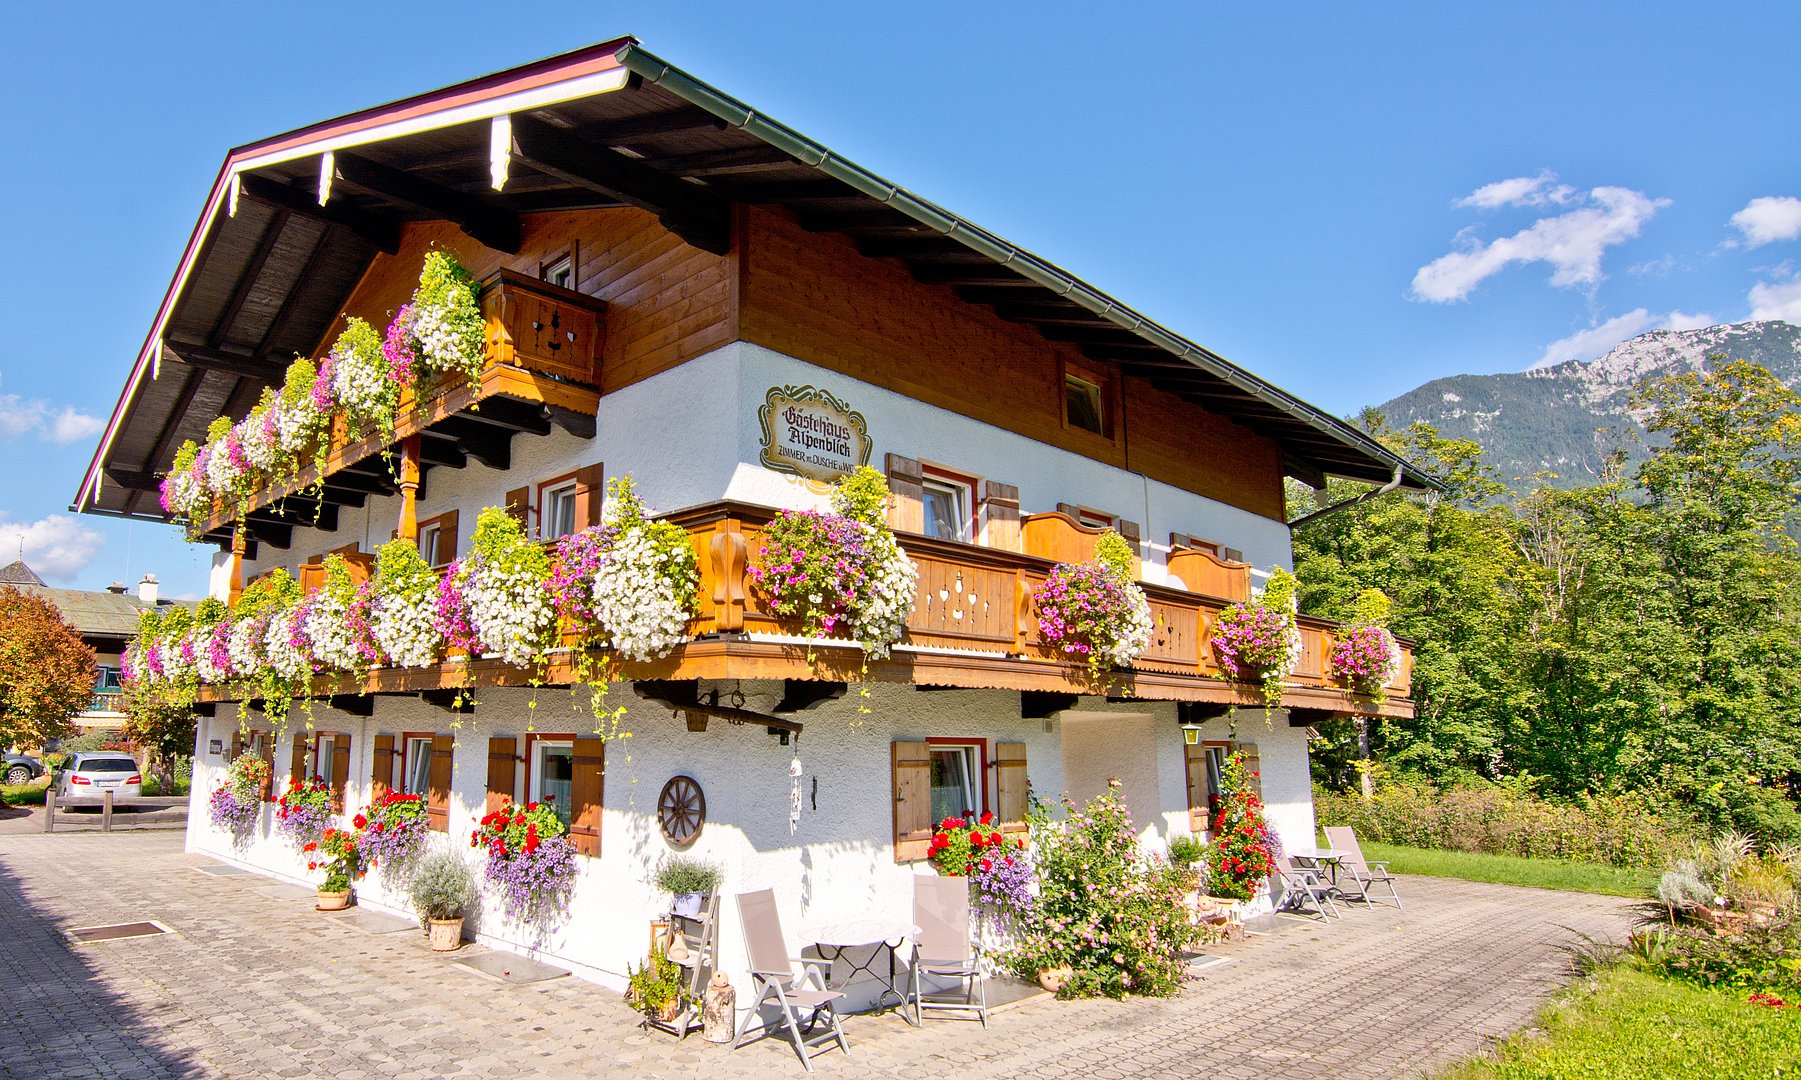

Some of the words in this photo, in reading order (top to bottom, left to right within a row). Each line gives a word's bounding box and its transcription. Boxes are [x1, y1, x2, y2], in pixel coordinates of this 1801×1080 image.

[782, 405, 851, 441] Gästehaus
[788, 426, 851, 457] Alpenblick
[778, 445, 805, 462] ZIMMER
[812, 454, 837, 470] DUSCHE
